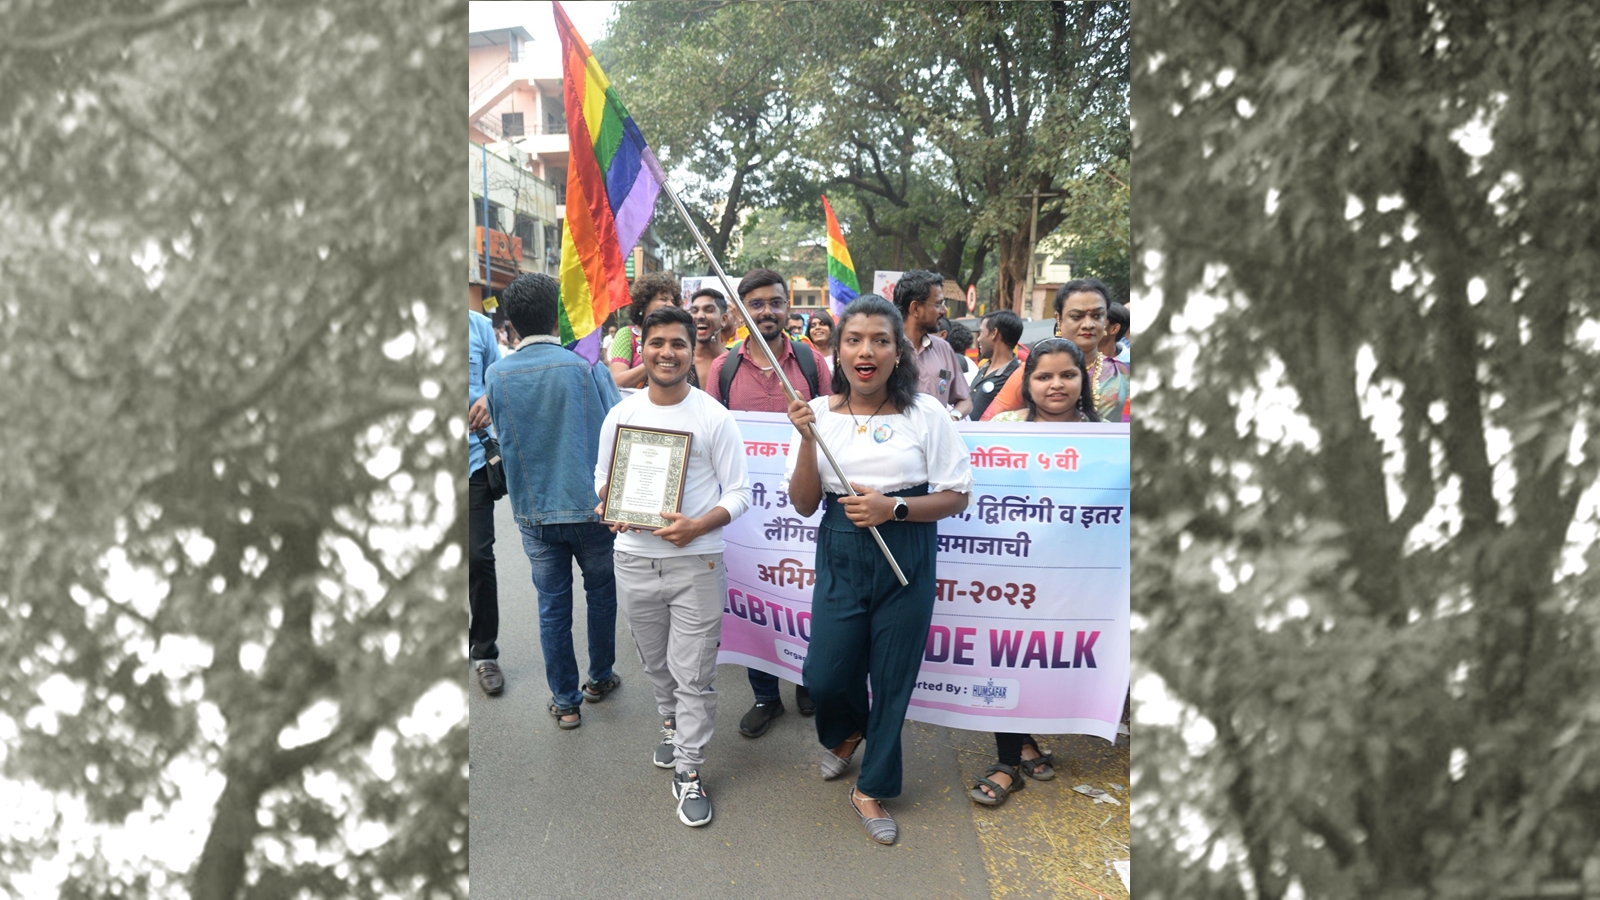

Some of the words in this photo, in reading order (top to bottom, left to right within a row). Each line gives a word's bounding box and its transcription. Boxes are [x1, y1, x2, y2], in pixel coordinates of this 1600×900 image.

[1055, 448, 1079, 470] वी
[1058, 505, 1077, 524] व
[1080, 506, 1124, 529] इतर
[989, 628, 1101, 669] WALK
[946, 683, 961, 695] By
[972, 685, 1007, 698] HUMSAFAR
